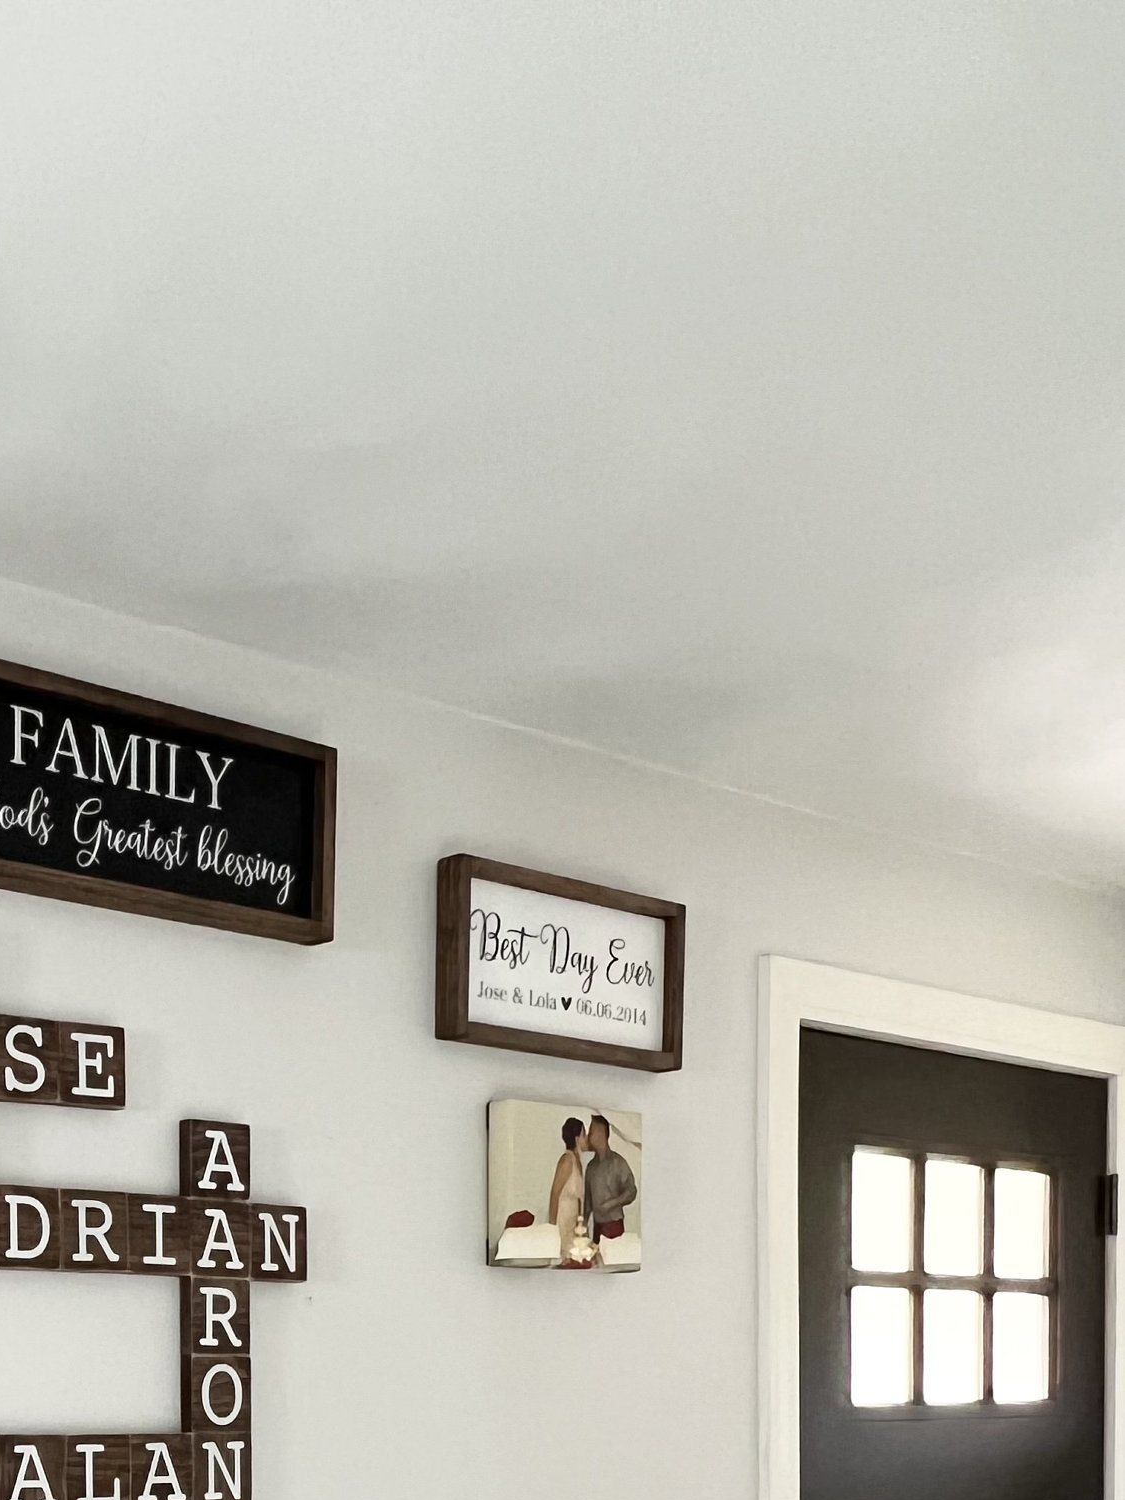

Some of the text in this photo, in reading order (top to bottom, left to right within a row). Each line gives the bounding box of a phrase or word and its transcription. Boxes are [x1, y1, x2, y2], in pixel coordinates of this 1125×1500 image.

[10, 704, 234, 810] FAMILY
[74, 798, 189, 867] Greatest
[197, 825, 296, 905] blessing
[470, 909, 655, 994] Best Day Ever
[477, 980, 647, 1026] Jose & Lola 06.06.2014
[197, 1130, 246, 1500] AARON
